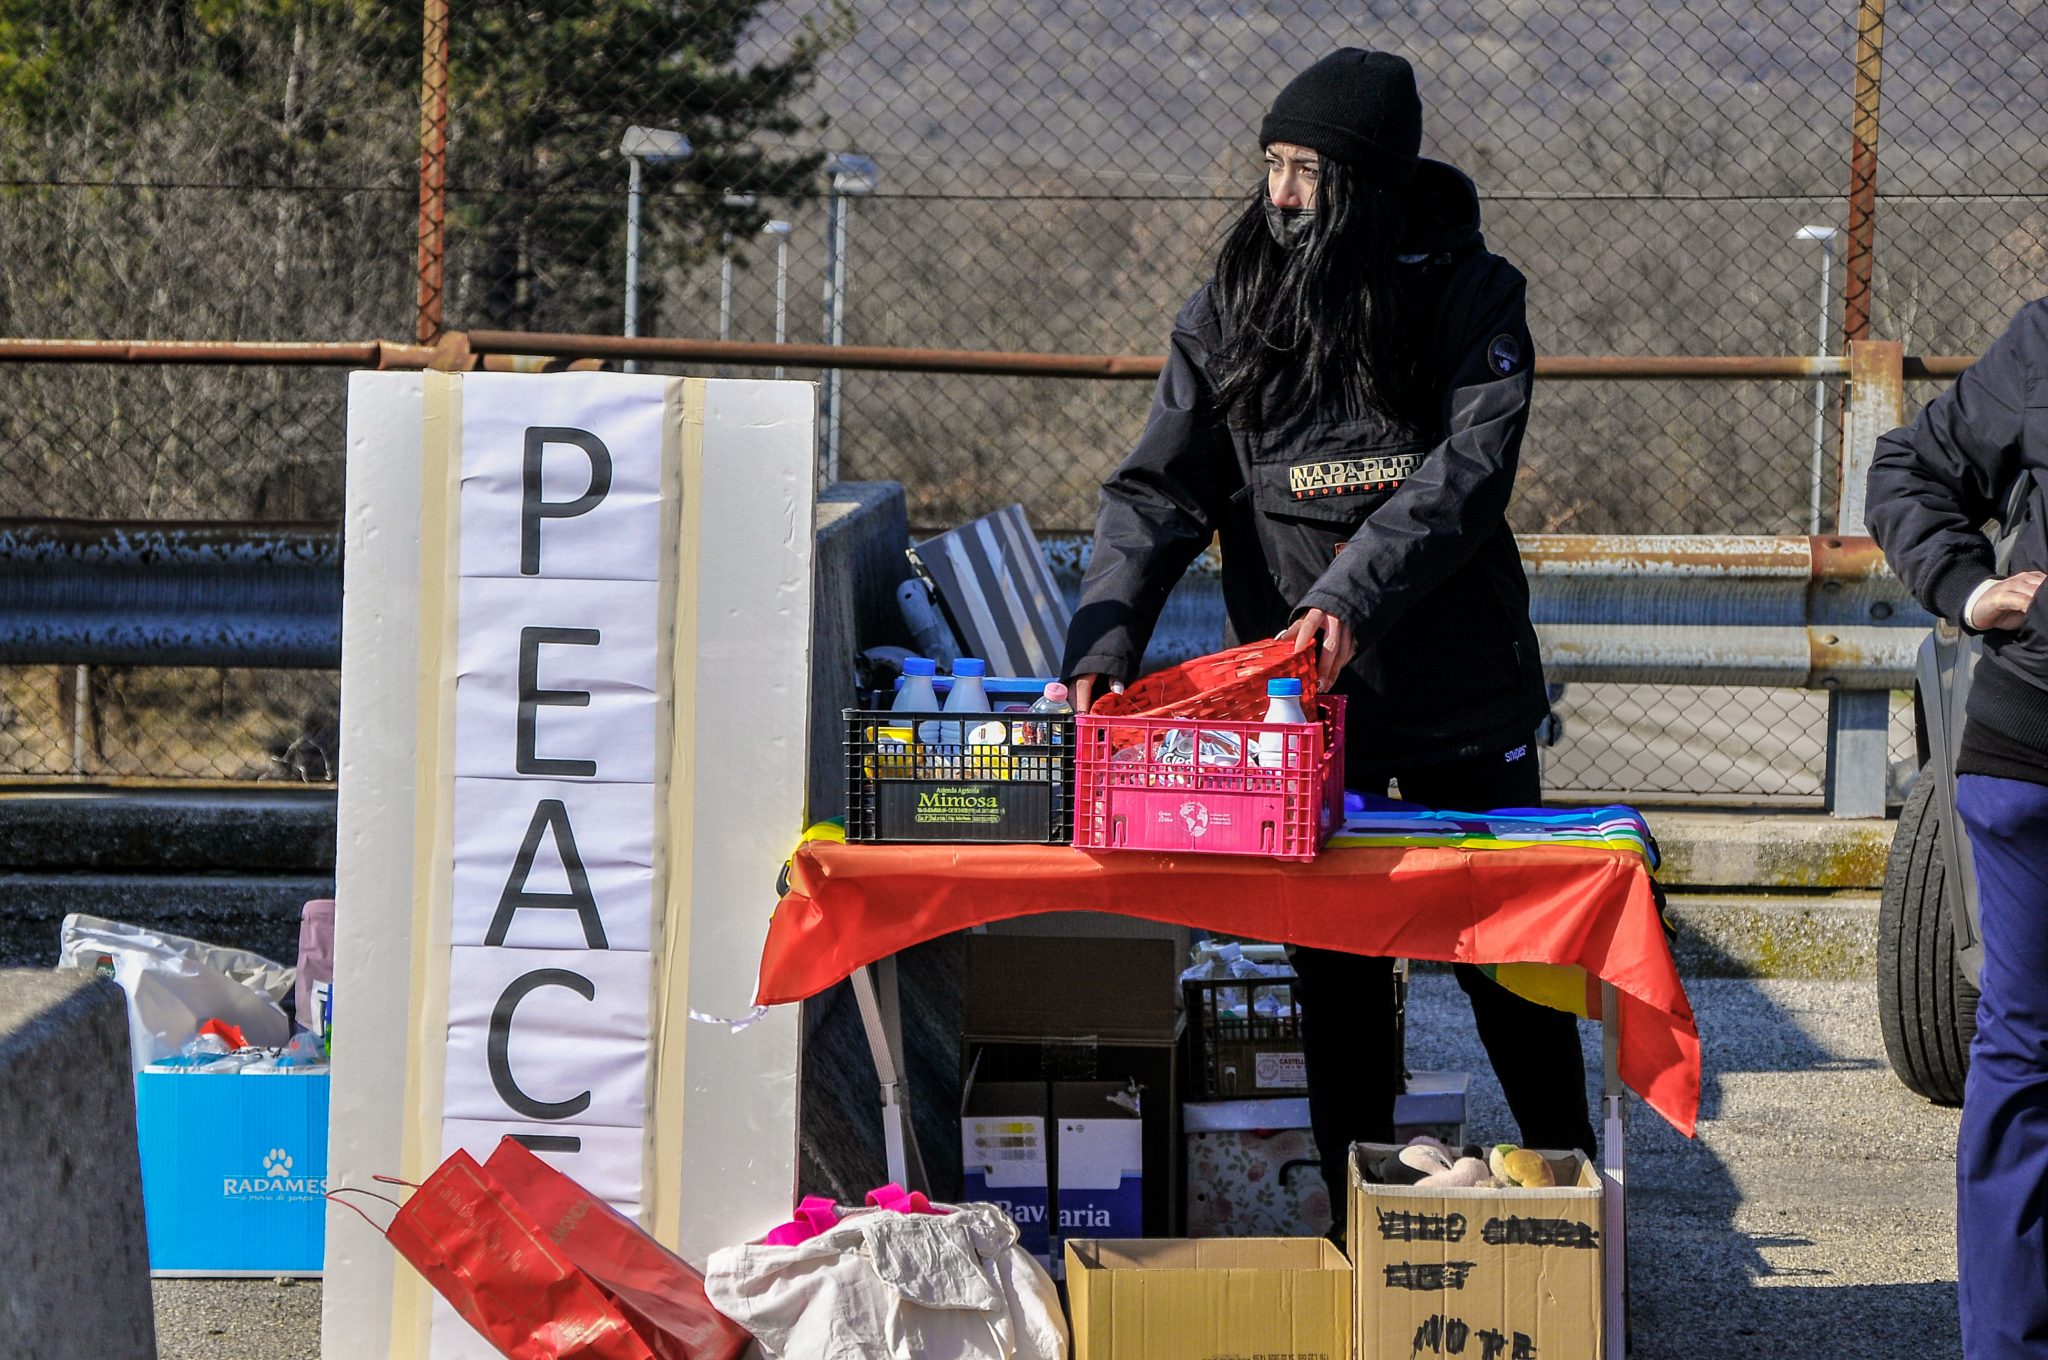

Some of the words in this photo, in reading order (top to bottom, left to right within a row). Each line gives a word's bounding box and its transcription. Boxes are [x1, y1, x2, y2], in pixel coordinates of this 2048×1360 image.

[483, 425, 613, 1154] PEAC
[918, 792, 999, 808] Mimosa
[223, 1178, 327, 1196] RADAMES
